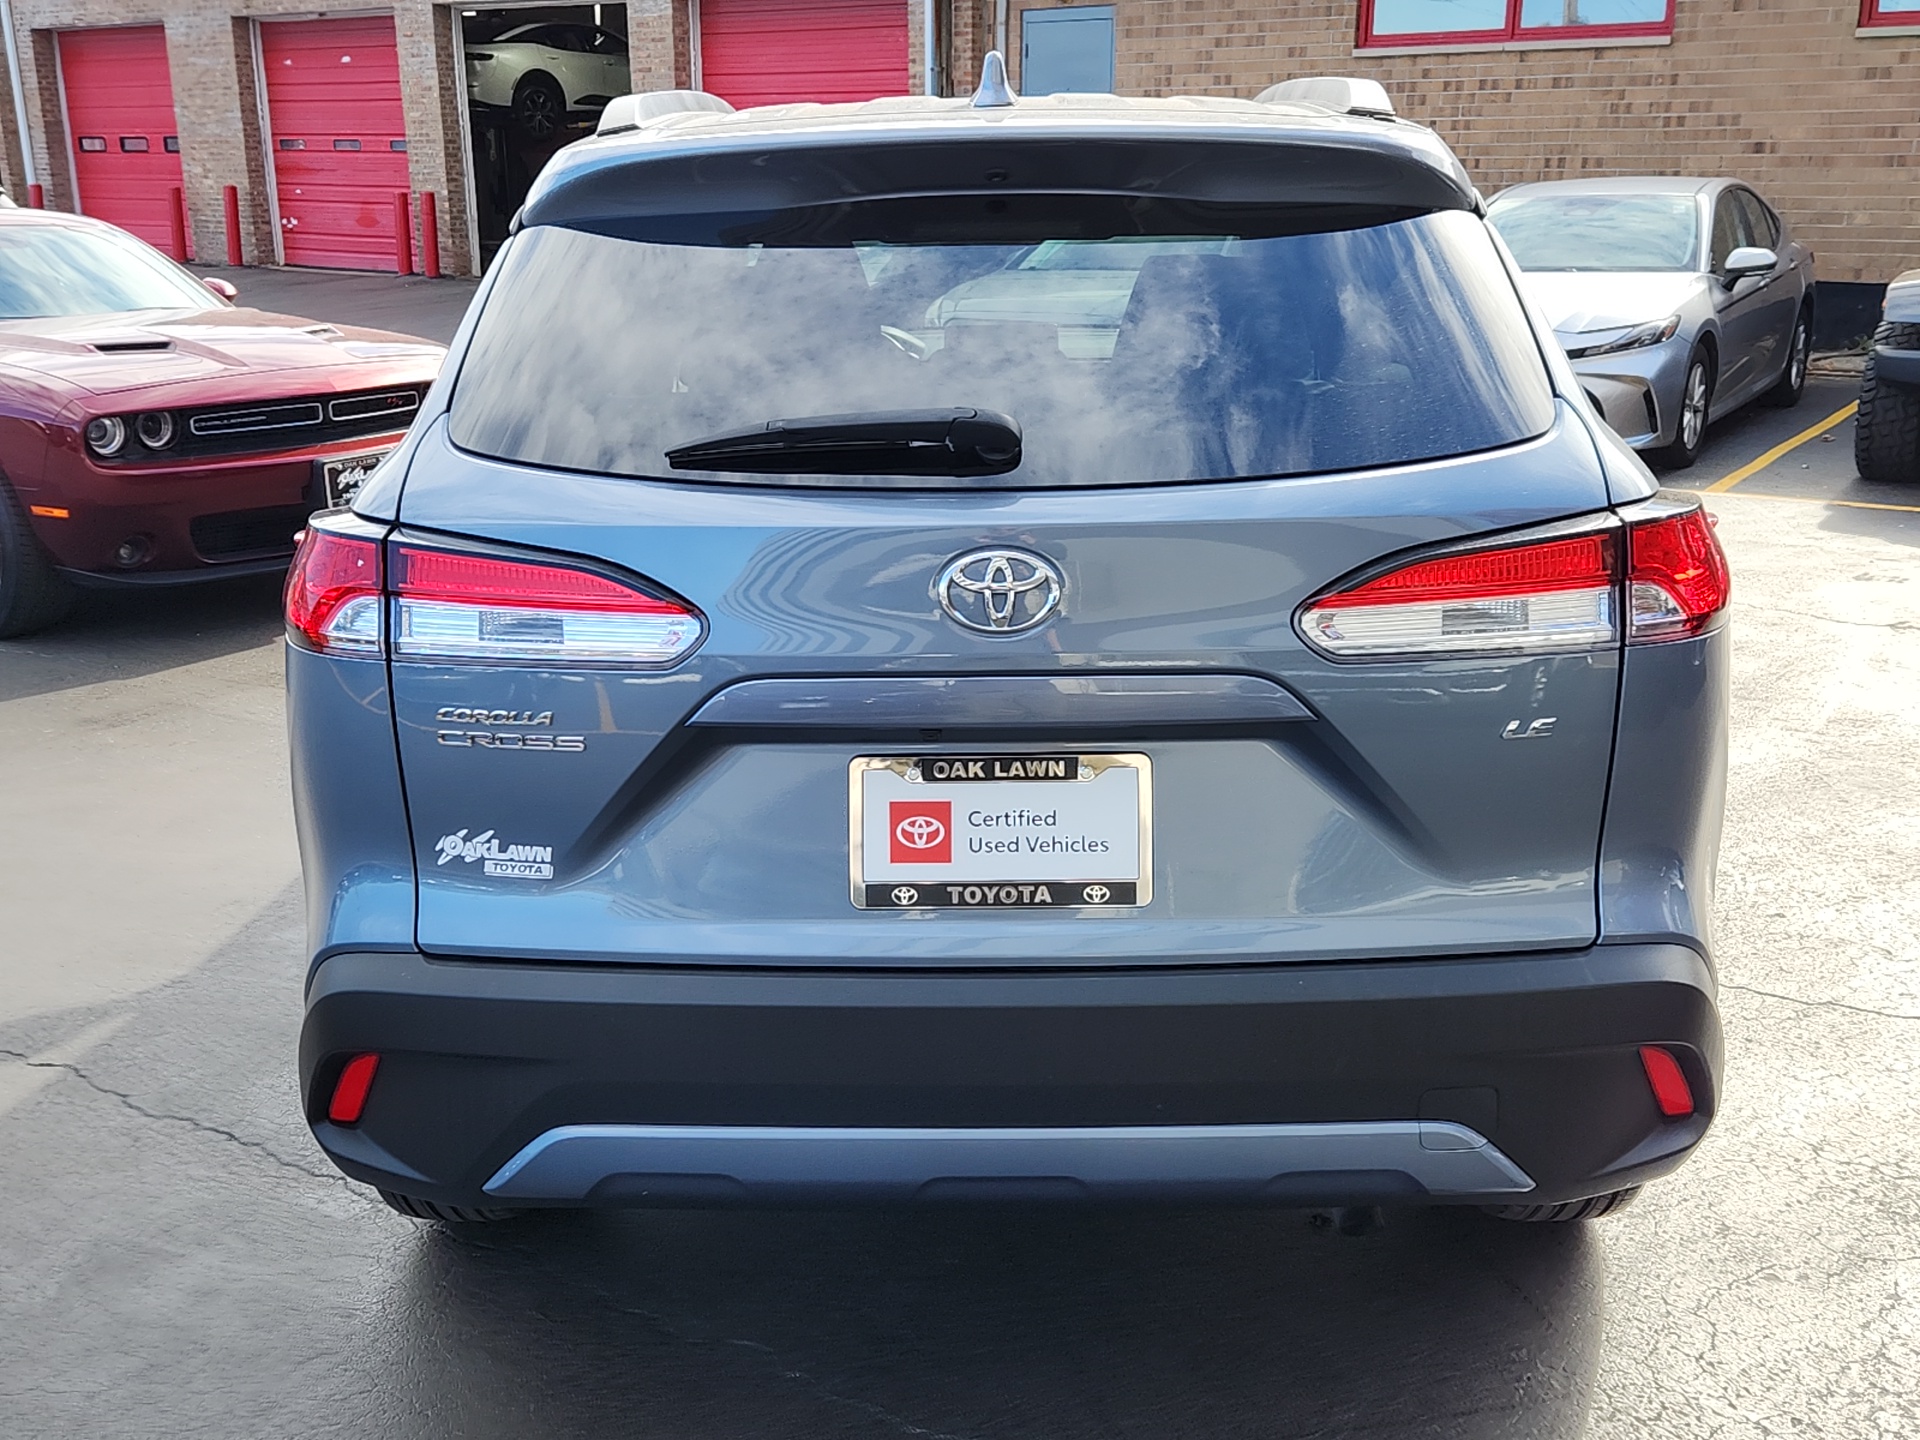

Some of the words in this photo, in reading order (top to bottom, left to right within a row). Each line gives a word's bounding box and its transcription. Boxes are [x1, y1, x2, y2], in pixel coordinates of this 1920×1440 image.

[436, 707, 553, 726] COROLLA
[1501, 717, 1557, 739] LE
[437, 730, 586, 752] CROSS
[933, 761, 985, 778] OAK
[994, 760, 1065, 778] LAWN
[968, 810, 1057, 828] Certified
[968, 836, 1020, 853] Used
[1025, 835, 1109, 853] Vehicles
[492, 862, 543, 875] TOYOTA
[947, 886, 1052, 905] TOYOTA
